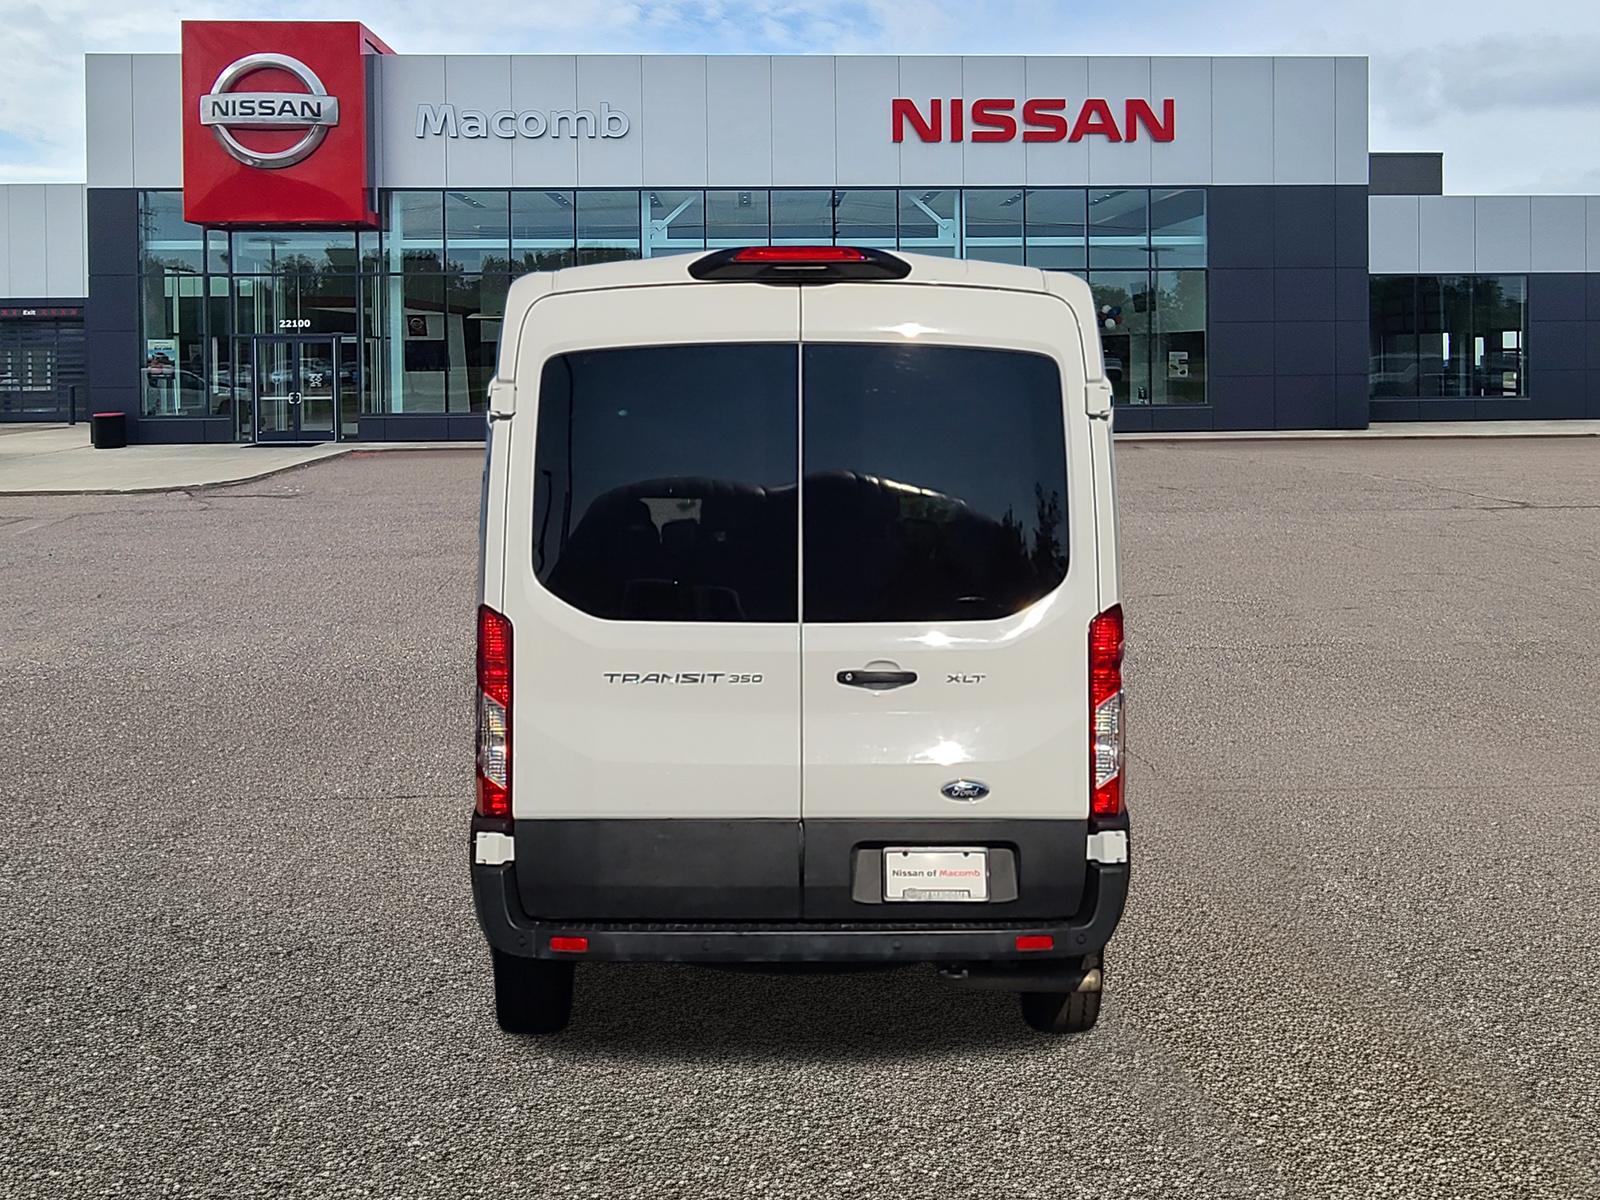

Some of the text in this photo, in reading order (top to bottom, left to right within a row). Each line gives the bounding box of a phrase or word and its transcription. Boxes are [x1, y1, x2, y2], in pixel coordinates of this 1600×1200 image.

[211, 100, 322, 118] NISSAN
[415, 102, 631, 139] Macomb
[892, 98, 1176, 143] NISSAN
[279, 319, 311, 328] 22100
[603, 673, 763, 684] TRANSIT 350
[946, 675, 986, 684] XLT
[951, 785, 979, 797] Ford
[892, 869, 981, 877] Nissan of Macomb
